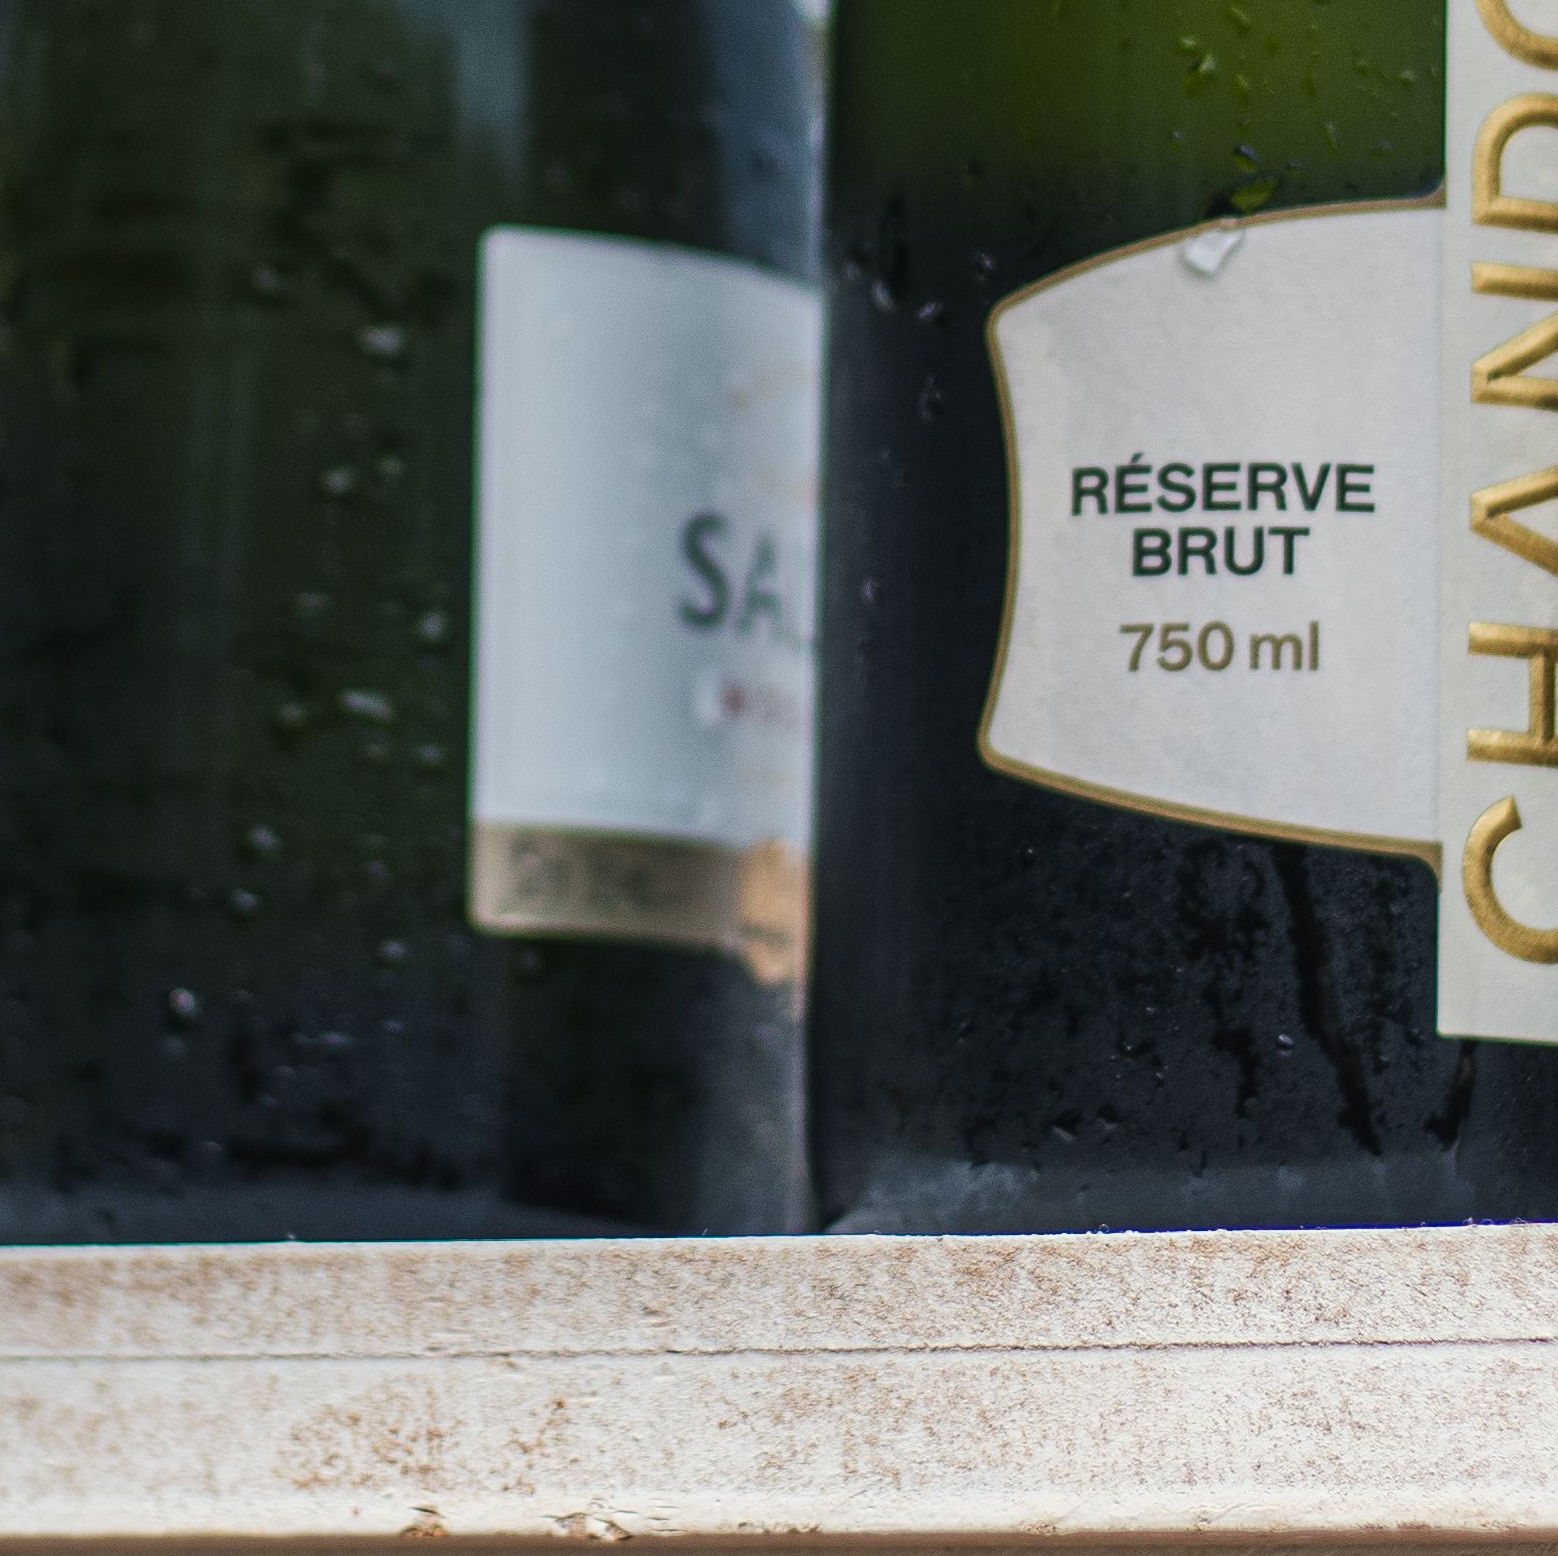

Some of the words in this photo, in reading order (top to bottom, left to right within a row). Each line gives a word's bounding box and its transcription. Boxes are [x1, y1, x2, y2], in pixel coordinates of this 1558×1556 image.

[1069, 452, 1376, 516] RÉSERVE
[1130, 525, 1311, 578] BRUT
[678, 508, 809, 656] SA
[1118, 620, 1236, 673] 750
[1247, 620, 1321, 673] ml
